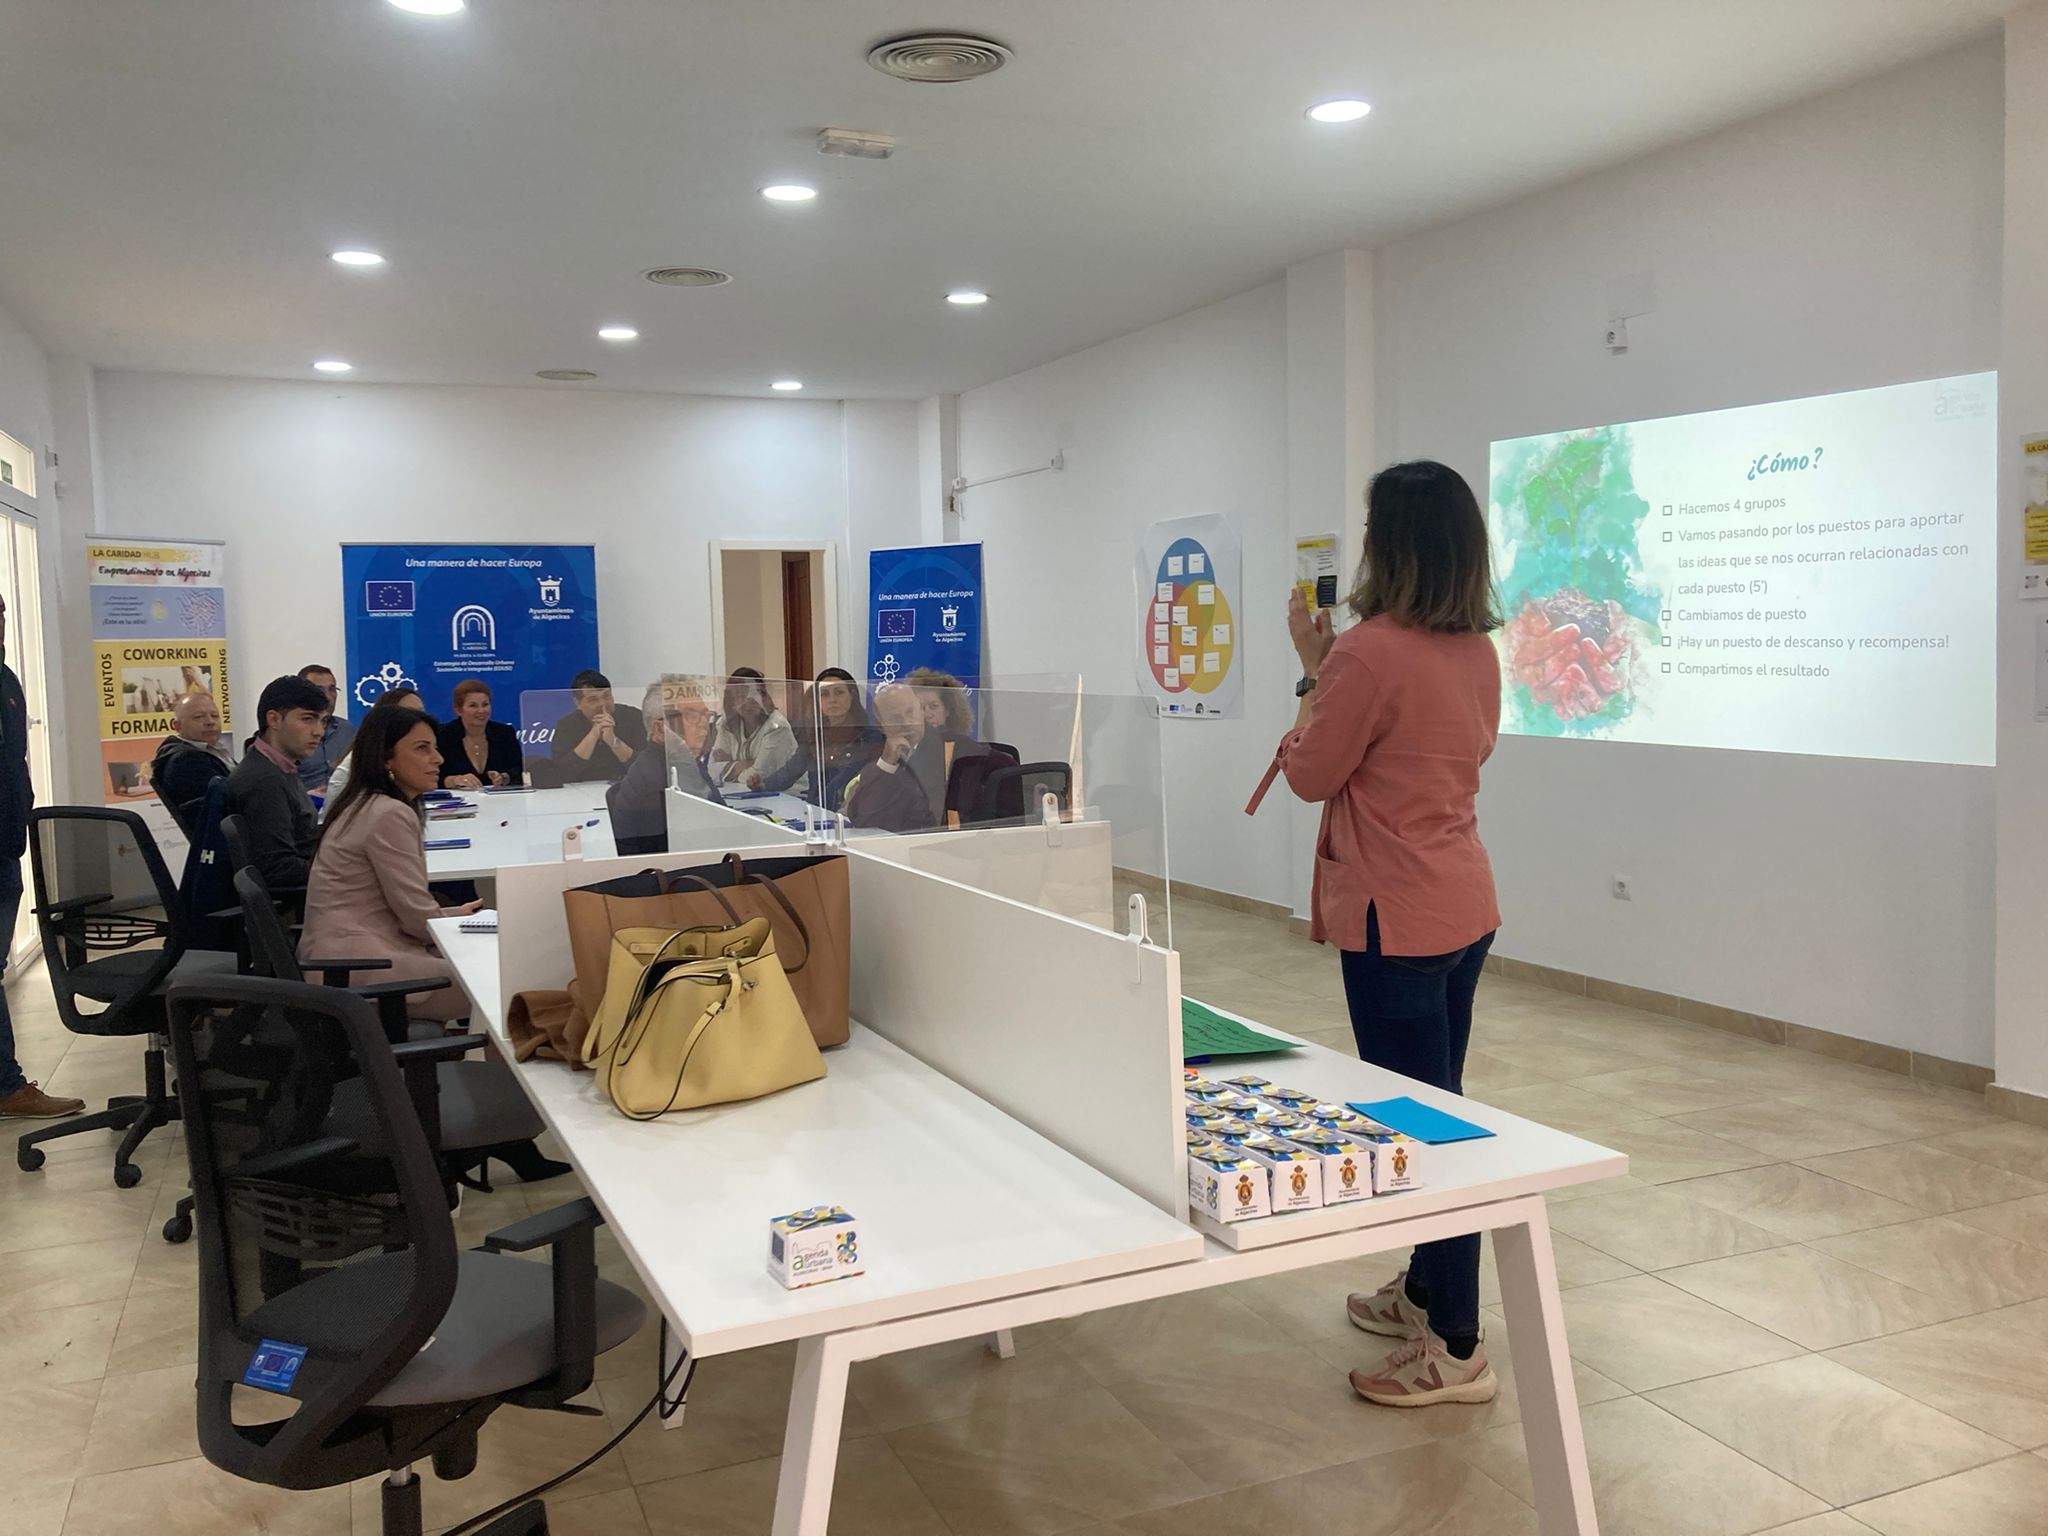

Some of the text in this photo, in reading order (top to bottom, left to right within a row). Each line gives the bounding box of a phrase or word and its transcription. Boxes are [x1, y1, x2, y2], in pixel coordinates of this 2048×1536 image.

[1747, 447, 1823, 481] ¿Cómo?
[1678, 497, 1786, 515] Hacemos 4 grupos
[1678, 512, 1965, 541] Vamos pasando por los puestos para aportar
[93, 549, 104, 557] LA
[105, 549, 142, 558] CARIDAD
[1678, 543, 1969, 568] las ideas que se nos ocurran relacionadas con
[405, 558, 543, 570] Una manera de hacer Europa
[878, 589, 974, 601] Una manera de hacer Europa
[1678, 582, 1704, 595] cada
[1706, 581, 1746, 596] puesto
[1677, 608, 1807, 622] Cambiamos de puesto
[1677, 635, 1949, 651] ¡Hay un puesto de descanso y recompensa!
[123, 647, 208, 661] COWORKING
[1677, 662, 1830, 677] Compartimos el resultado
[101, 652, 115, 707] EVENTOS
[218, 648, 231, 724] NETWORKING
